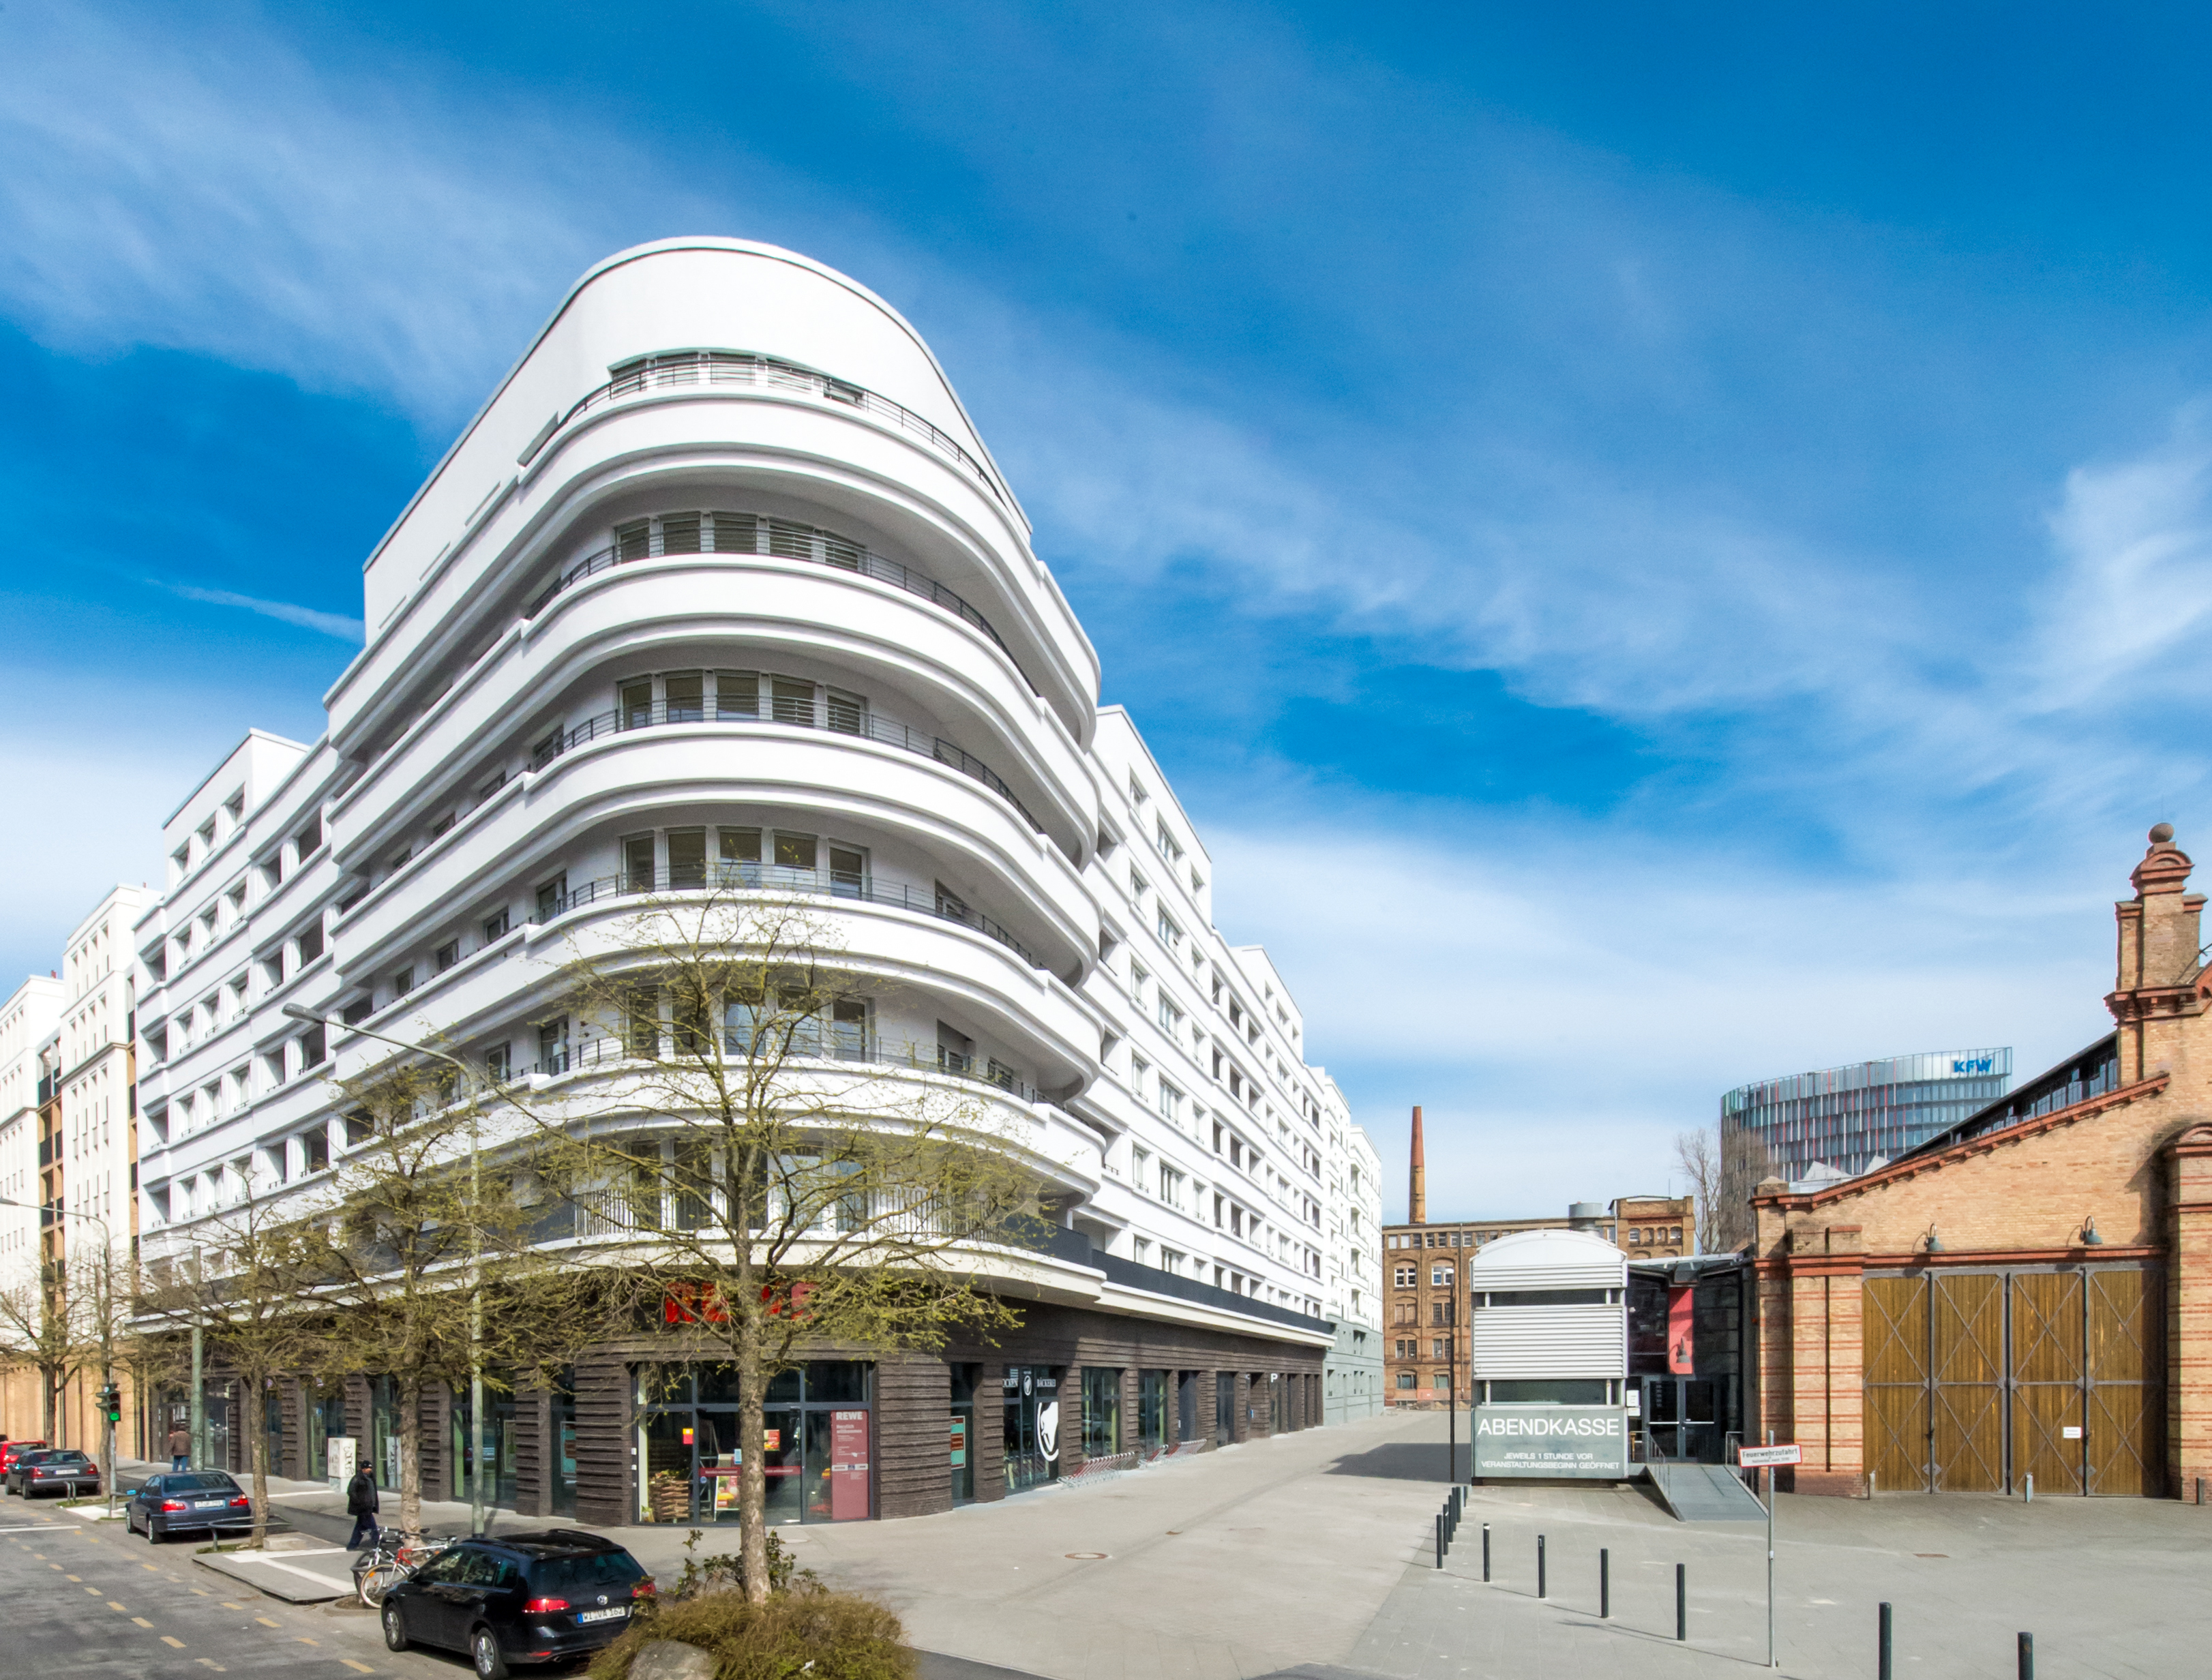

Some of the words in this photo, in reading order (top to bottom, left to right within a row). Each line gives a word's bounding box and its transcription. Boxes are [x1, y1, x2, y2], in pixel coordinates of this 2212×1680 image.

[836, 1411, 863, 1420] REWE
[1478, 1418, 1619, 1436] ABENDKASSE
[1743, 1448, 1797, 1458] Feuerwehrzufahrt
